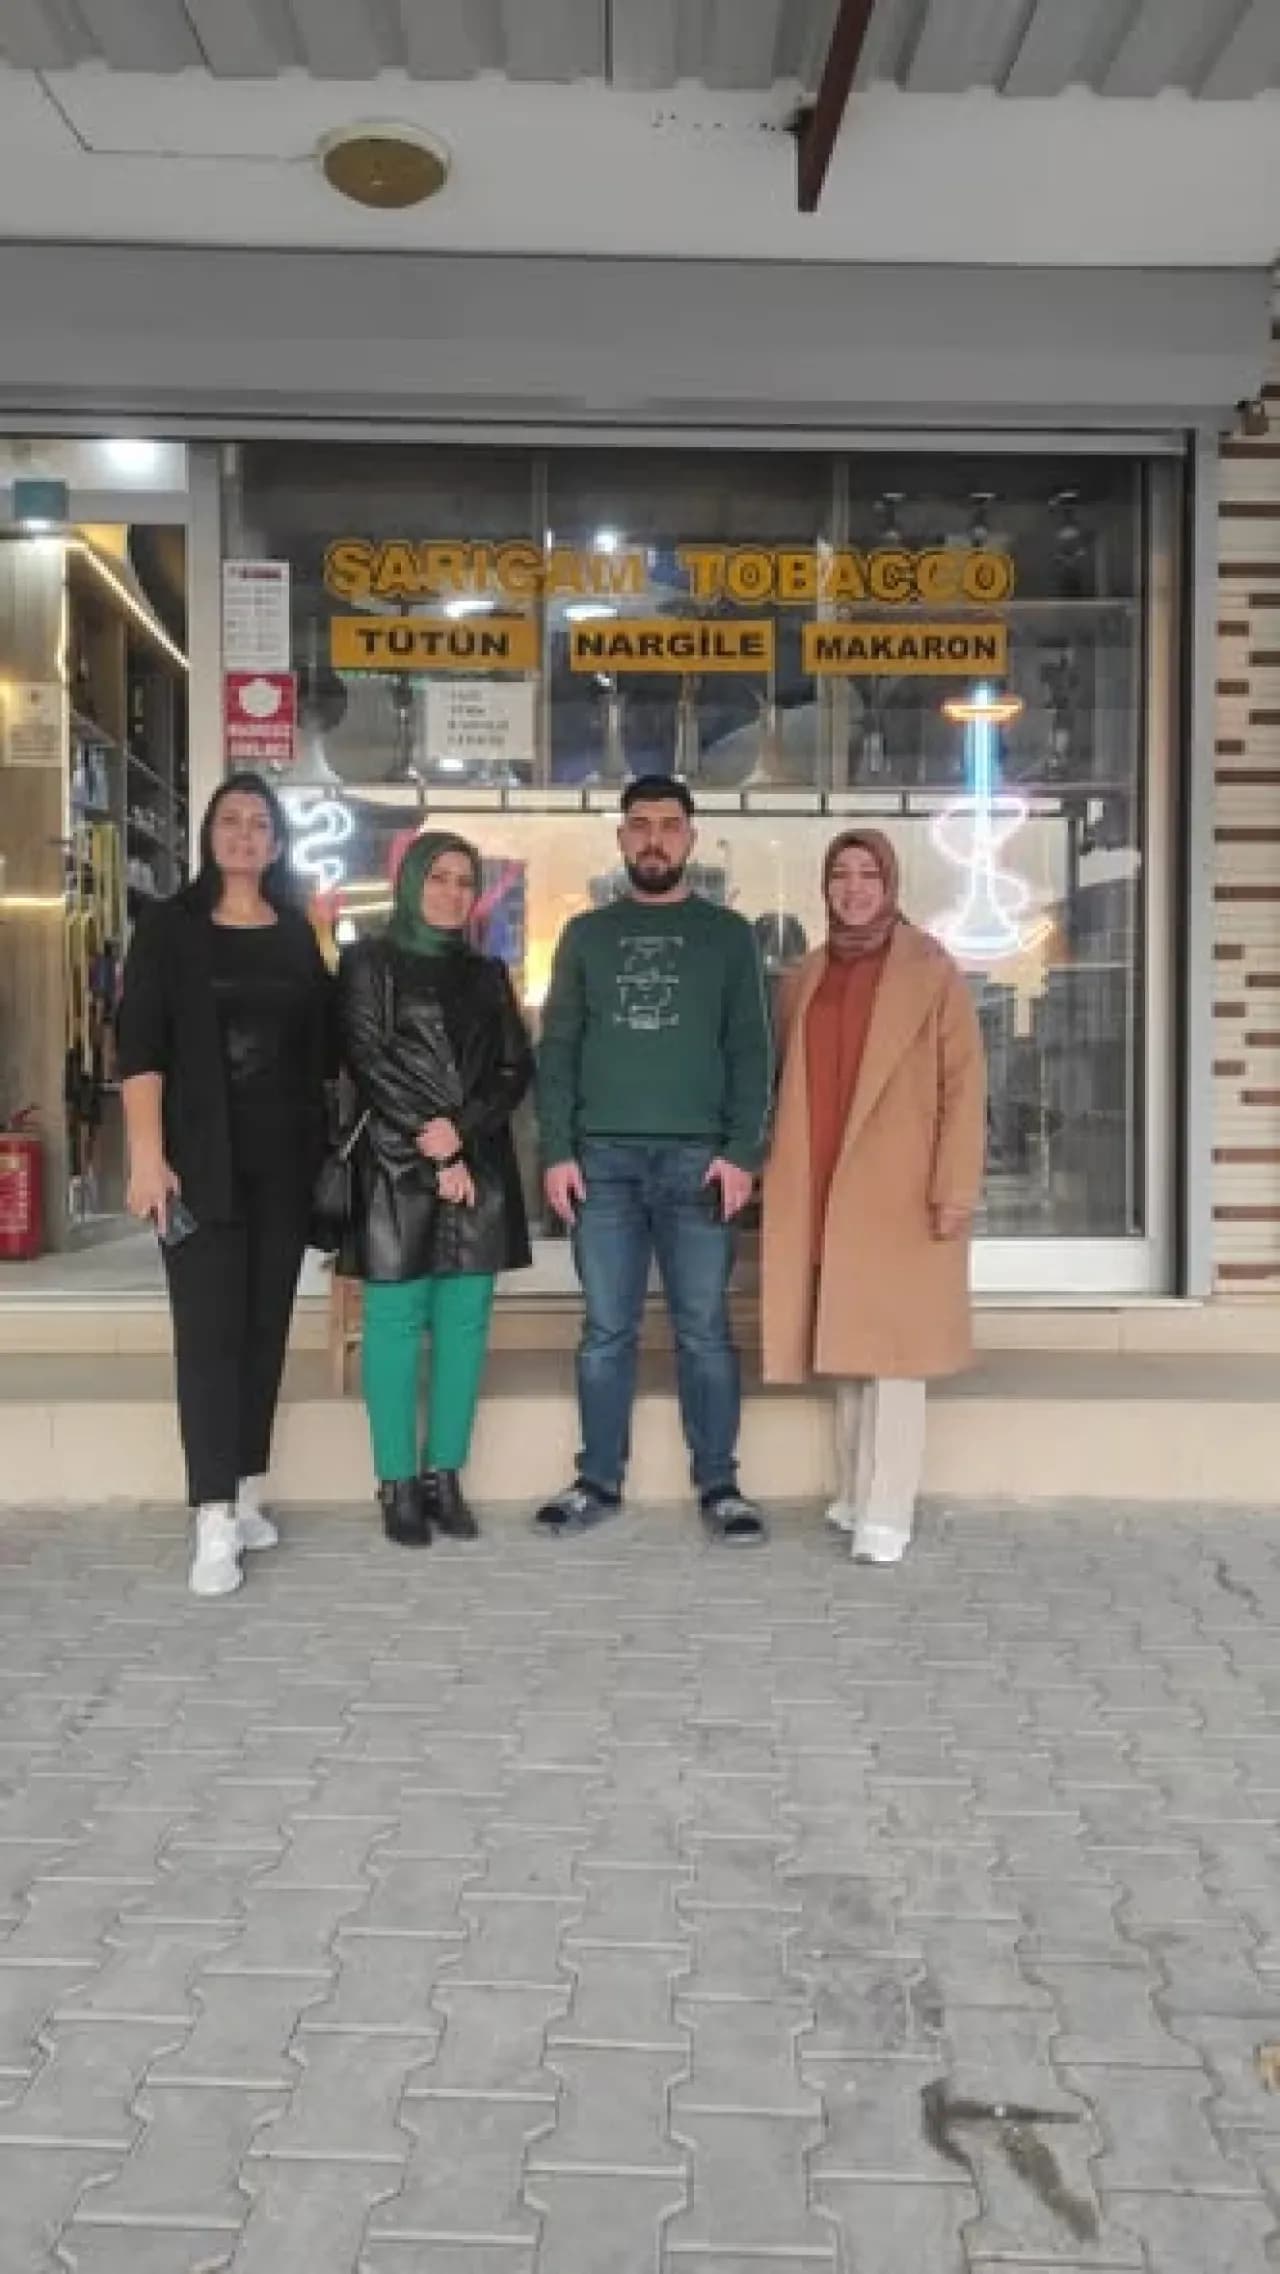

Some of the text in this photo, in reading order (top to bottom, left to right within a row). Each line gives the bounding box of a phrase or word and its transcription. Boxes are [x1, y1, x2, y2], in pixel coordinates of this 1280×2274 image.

[678, 544, 1014, 604] TOBACCO
[357, 625, 511, 657] TÜTÜN
[576, 625, 766, 657] NARGİLE
[815, 634, 998, 660] MAKARON
